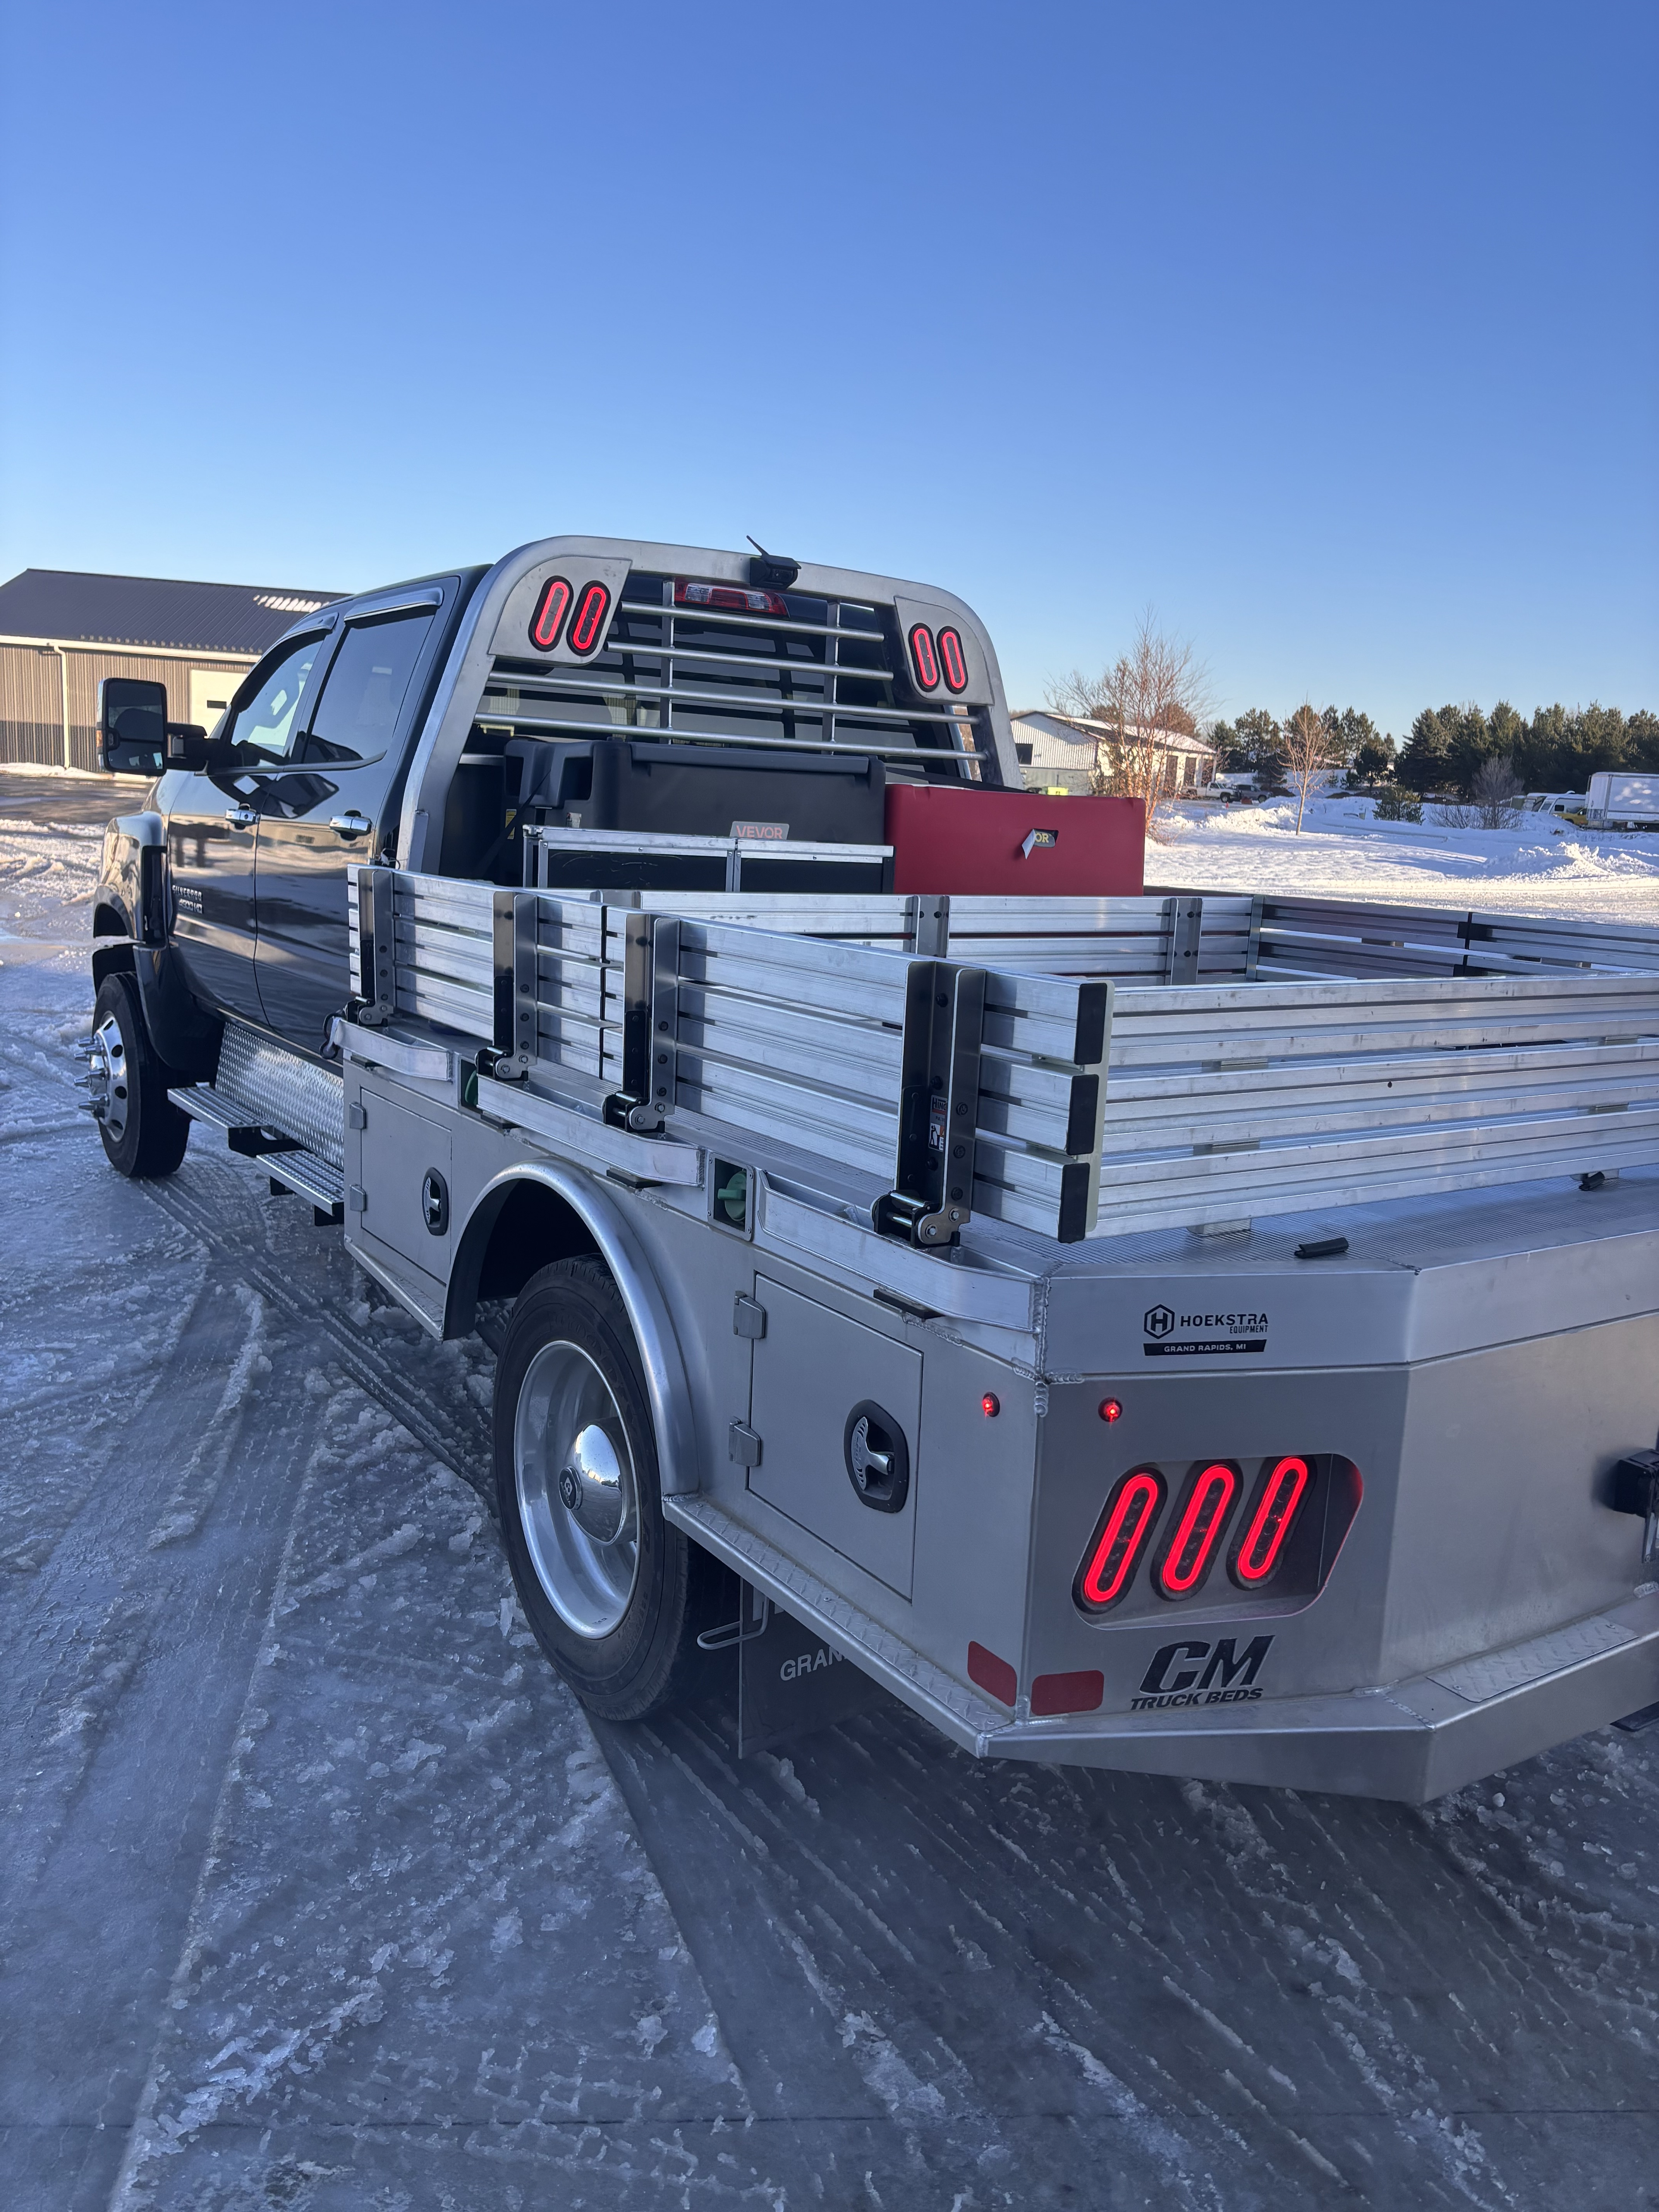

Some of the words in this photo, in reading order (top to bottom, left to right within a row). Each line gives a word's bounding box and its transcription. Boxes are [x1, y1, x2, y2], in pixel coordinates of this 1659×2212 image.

[736, 825, 783, 840] VEVOR
[1180, 1313, 1268, 1327] HOEKSTRA
[1229, 1325, 1269, 1334] EQUIPMENT
[780, 1646, 847, 1681] GRAN
[1139, 1635, 1276, 1695] CM
[1130, 1693, 1203, 1710] TRUCK
[1204, 1688, 1264, 1704] BEDS
